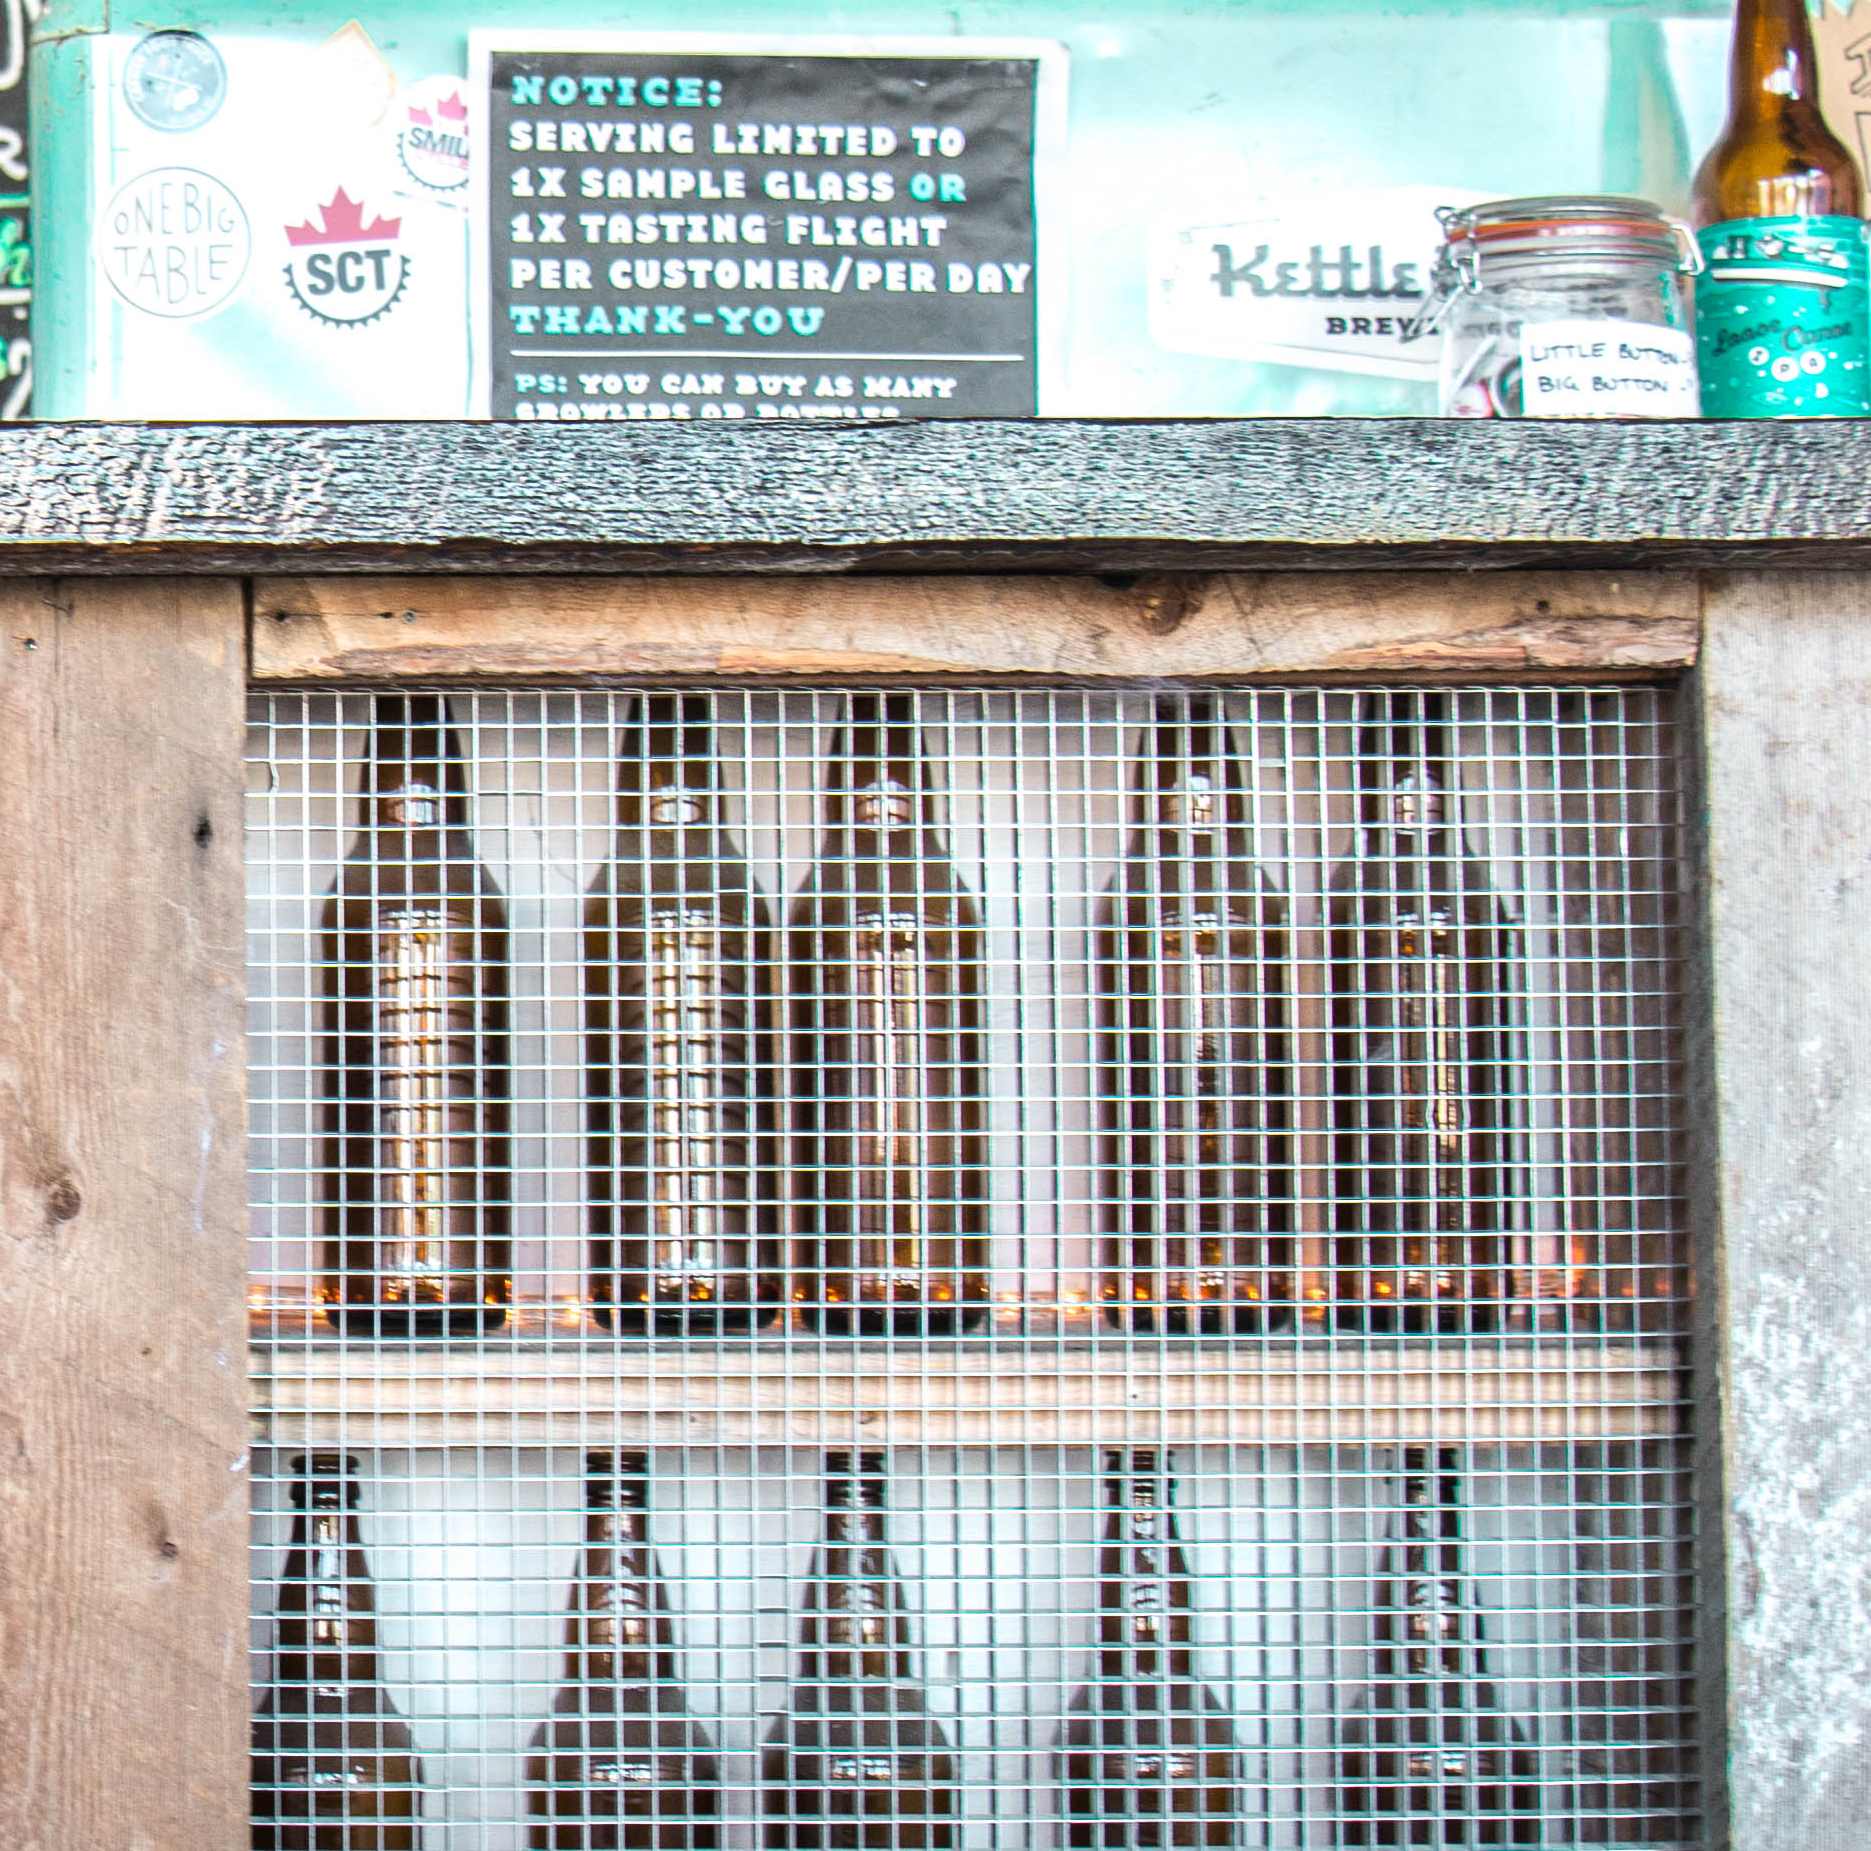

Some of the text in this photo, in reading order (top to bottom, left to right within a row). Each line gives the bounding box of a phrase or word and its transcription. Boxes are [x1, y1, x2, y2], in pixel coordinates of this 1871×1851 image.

[510, 75, 723, 109] NOTICE:
[510, 121, 967, 158] SERVING LIMITED TO
[510, 167, 967, 203] 1X SAMPLE GLASS OR
[510, 213, 948, 248] 1X TASTING FLIGHT
[113, 243, 235, 306] TABLE
[306, 248, 392, 297] SCT
[510, 258, 592, 291] PER
[947, 262, 1032, 295] DAY
[1210, 243, 1424, 299] Kettle
[510, 304, 826, 336] THANK-YOU
[1530, 342, 1608, 362] LITTLE
[514, 373, 958, 399] PS: YOU CAN BUY AS MANY
[1538, 375, 1669, 393] BIG BUTTON
